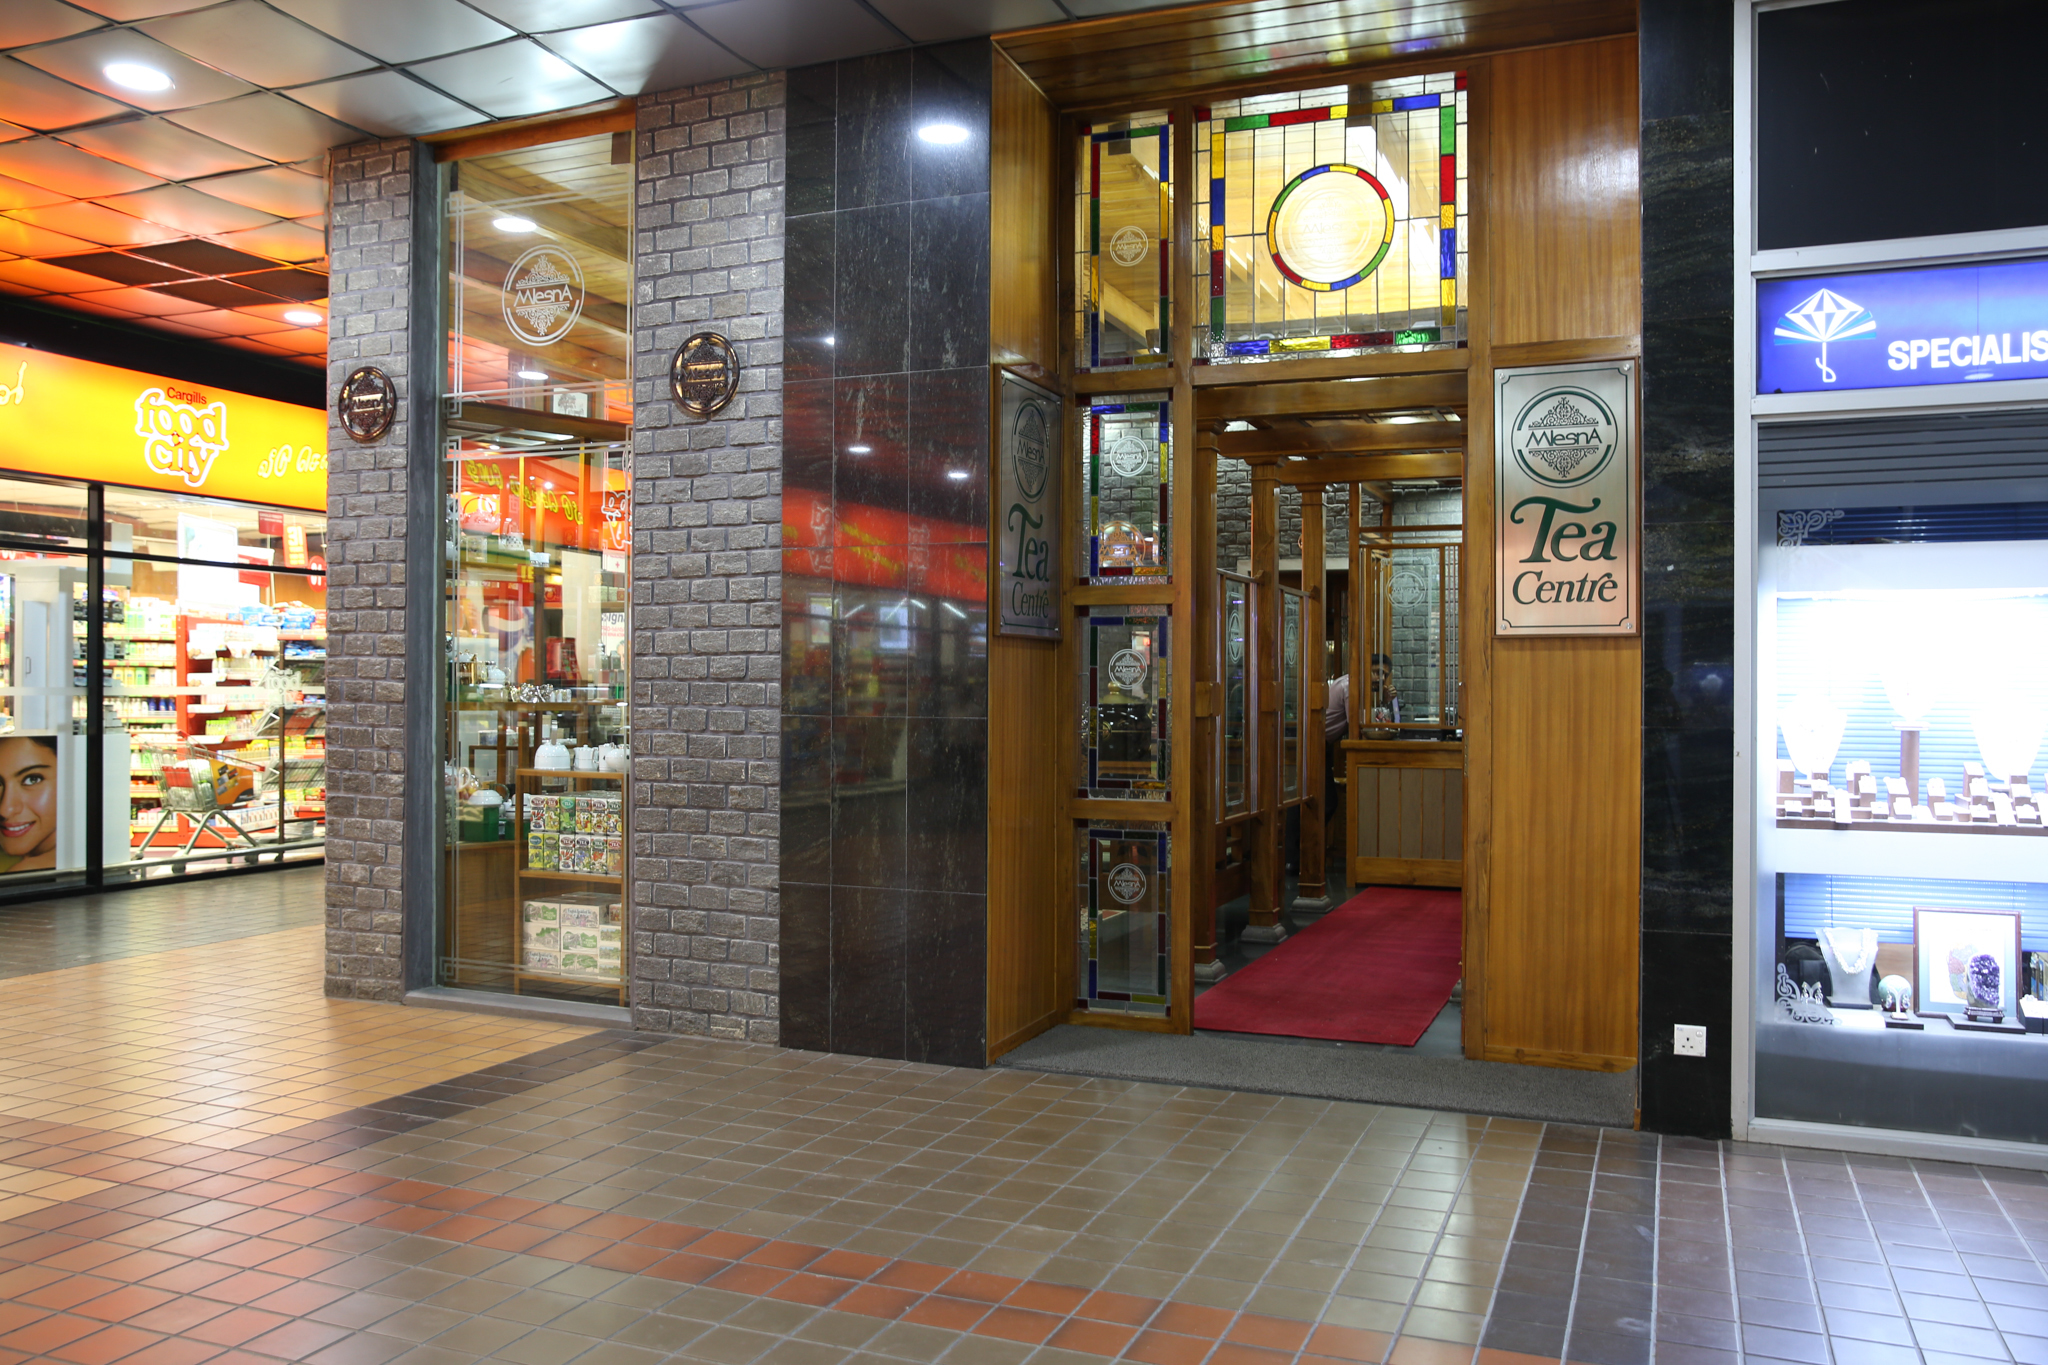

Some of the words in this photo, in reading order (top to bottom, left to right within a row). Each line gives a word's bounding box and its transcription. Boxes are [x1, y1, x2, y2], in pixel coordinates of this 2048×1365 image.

[1887, 330, 2048, 371] SPECIALIS
[136, 388, 229, 450] food
[166, 386, 207, 405] Cargills
[145, 433, 219, 487] city
[1008, 503, 1050, 583] Tea
[1510, 496, 1618, 563] Tea
[1012, 581, 1050, 619] Centre
[1512, 570, 1618, 605] Centre
